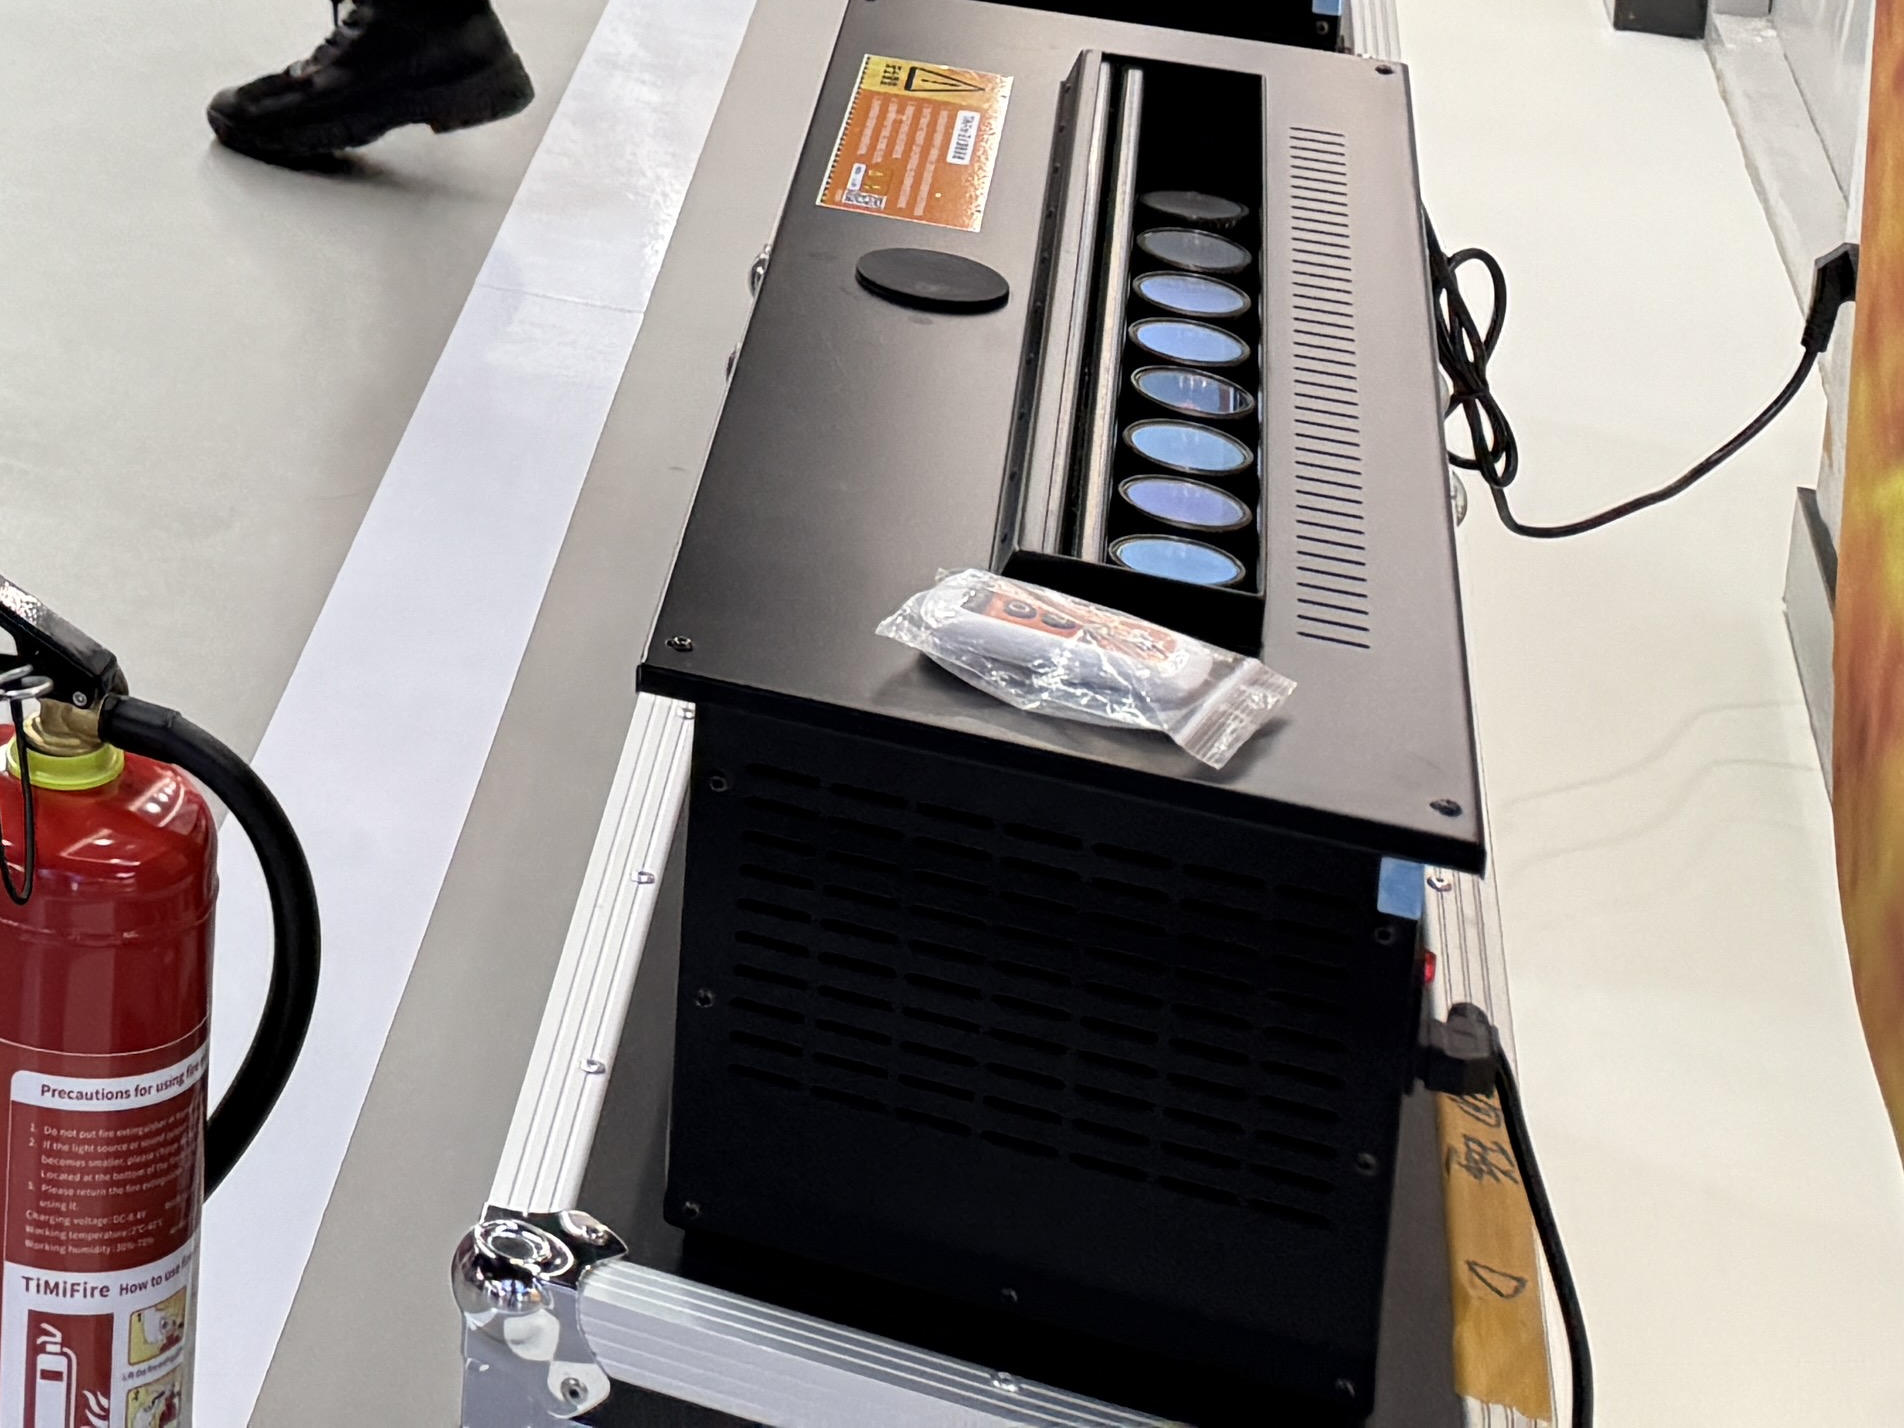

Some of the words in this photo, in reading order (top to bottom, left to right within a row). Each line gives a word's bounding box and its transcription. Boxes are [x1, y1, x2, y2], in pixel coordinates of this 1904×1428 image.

[41, 1083, 131, 1101] Precautions
[134, 1083, 153, 1097] for
[155, 1072, 185, 1093] using
[44, 1125, 58, 1136] Do
[60, 1127, 77, 1138] not
[79, 1129, 96, 1140] put
[98, 1128, 114, 1139] fire
[53, 1142, 69, 1152] the
[72, 1141, 95, 1154] light
[97, 1143, 128, 1153] source
[41, 1155, 86, 1167] becomes
[41, 1169, 81, 1182] Located
[95, 1171, 110, 1182] the
[41, 1183, 74, 1196] Please
[77, 1185, 107, 1196] return
[109, 1184, 124, 1194] the
[39, 1199, 67, 1211] using
[25, 1209, 71, 1226] Charging
[25, 1225, 67, 1239] Working
[24, 1239, 66, 1254] Working
[21, 1275, 111, 1298] TiMiFire
[119, 1279, 149, 1297] How
[150, 1274, 163, 1288] to
[164, 1266, 180, 1282] use
